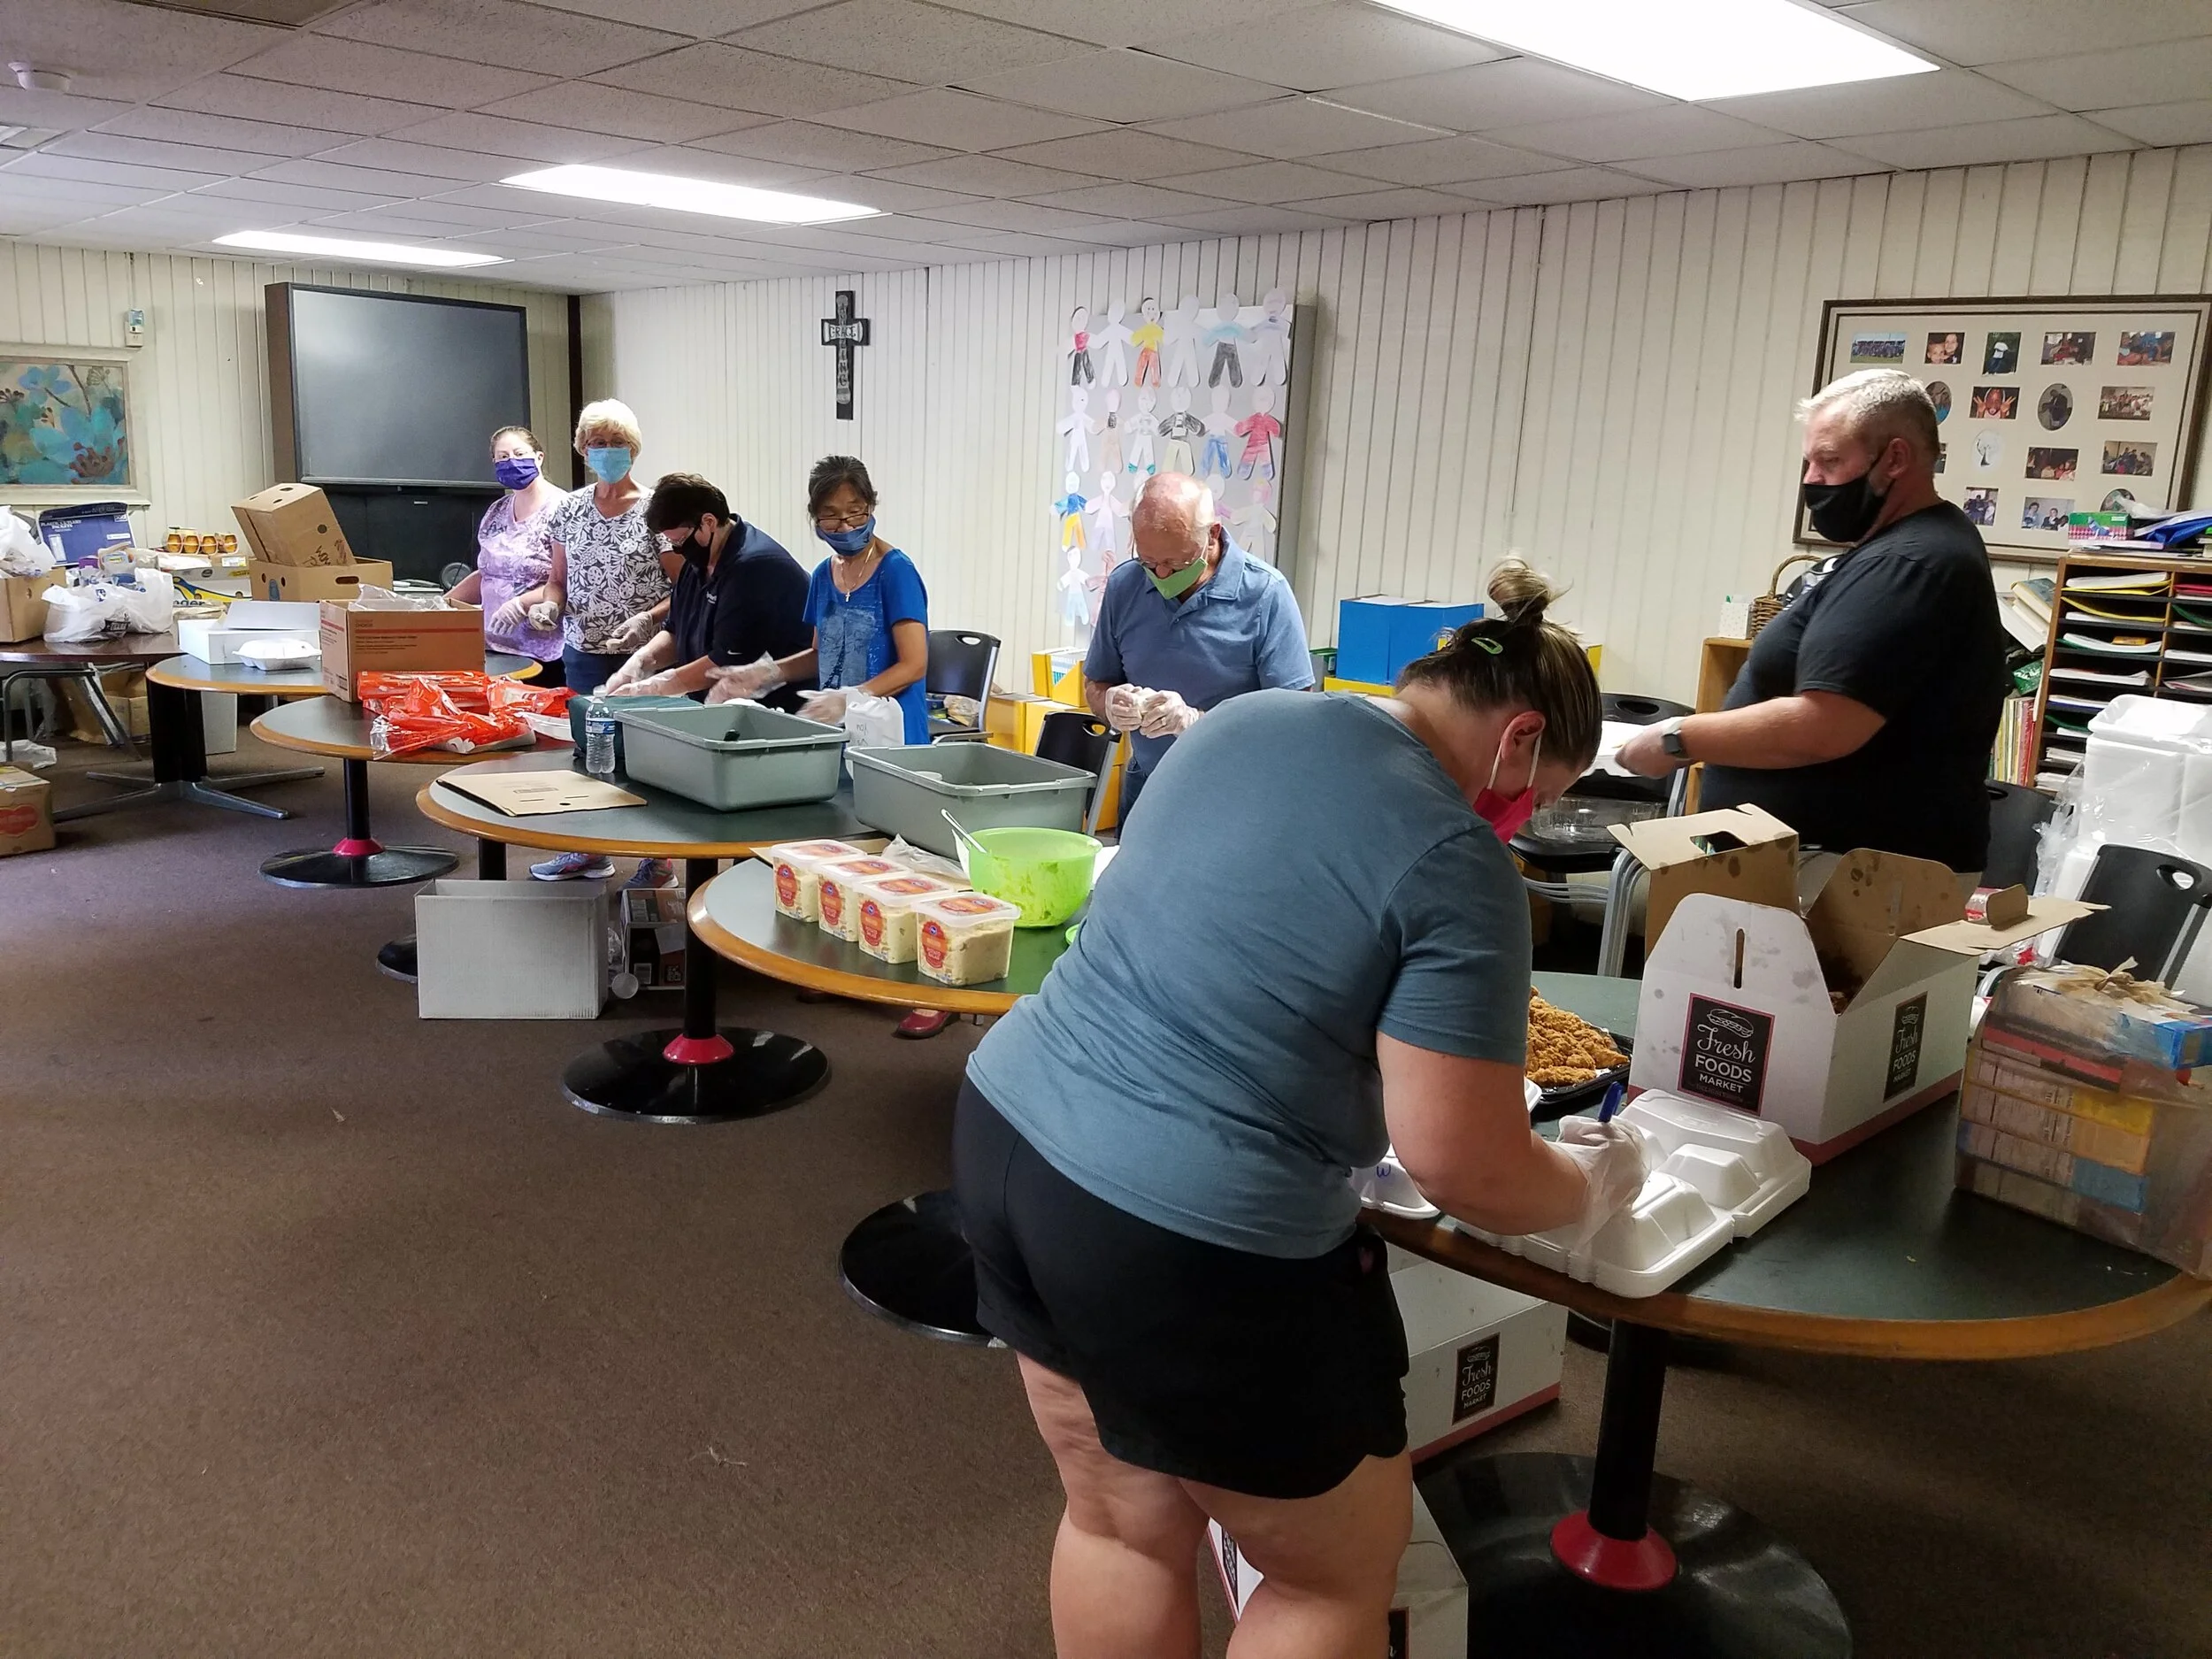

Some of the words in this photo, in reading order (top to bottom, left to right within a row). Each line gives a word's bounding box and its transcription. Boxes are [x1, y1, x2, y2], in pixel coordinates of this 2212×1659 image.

[829, 326, 856, 338] GRACE
[1697, 1024, 1756, 1064] Fresh
[1895, 1025, 1918, 1053] Fresh
[1694, 1054, 1753, 1083] FOODS
[1893, 1049, 1916, 1071] FOODS
[1699, 1073, 1744, 1094] MARKET
[1462, 1360, 1492, 1386] Fresh
[1461, 1379, 1491, 1402] FOODS
[1463, 1394, 1486, 1409] MARKET
